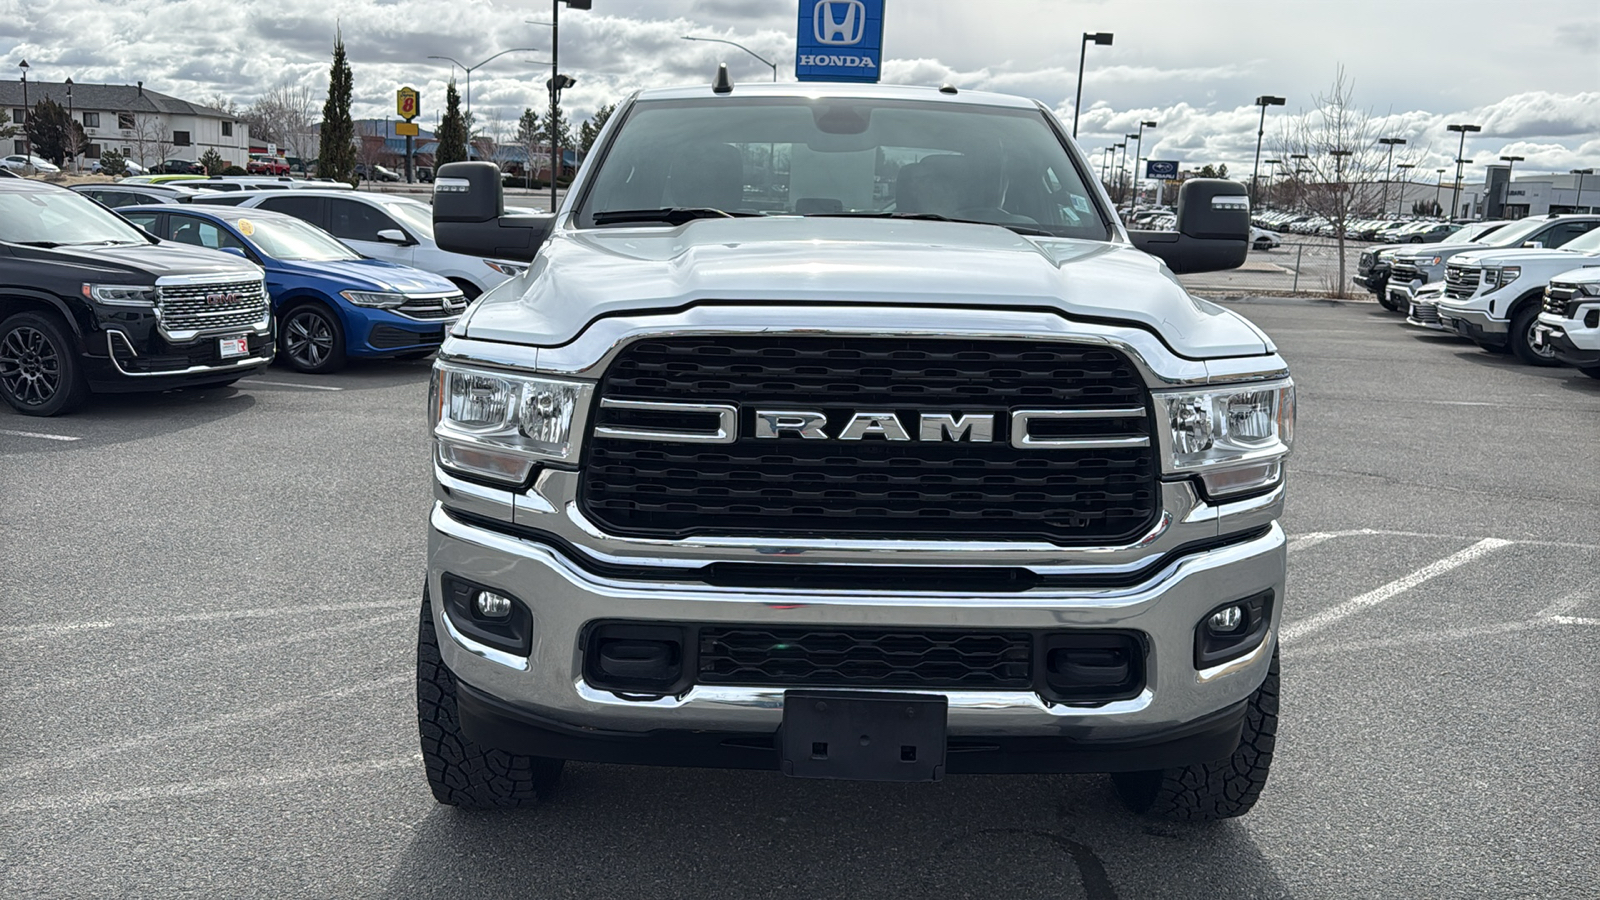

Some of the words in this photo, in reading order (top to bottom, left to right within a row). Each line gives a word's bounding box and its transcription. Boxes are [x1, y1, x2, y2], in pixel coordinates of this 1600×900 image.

[799, 54, 876, 68] HONDA
[402, 97, 414, 112] 8
[206, 292, 243, 305] GMC
[755, 410, 995, 442] RAM
